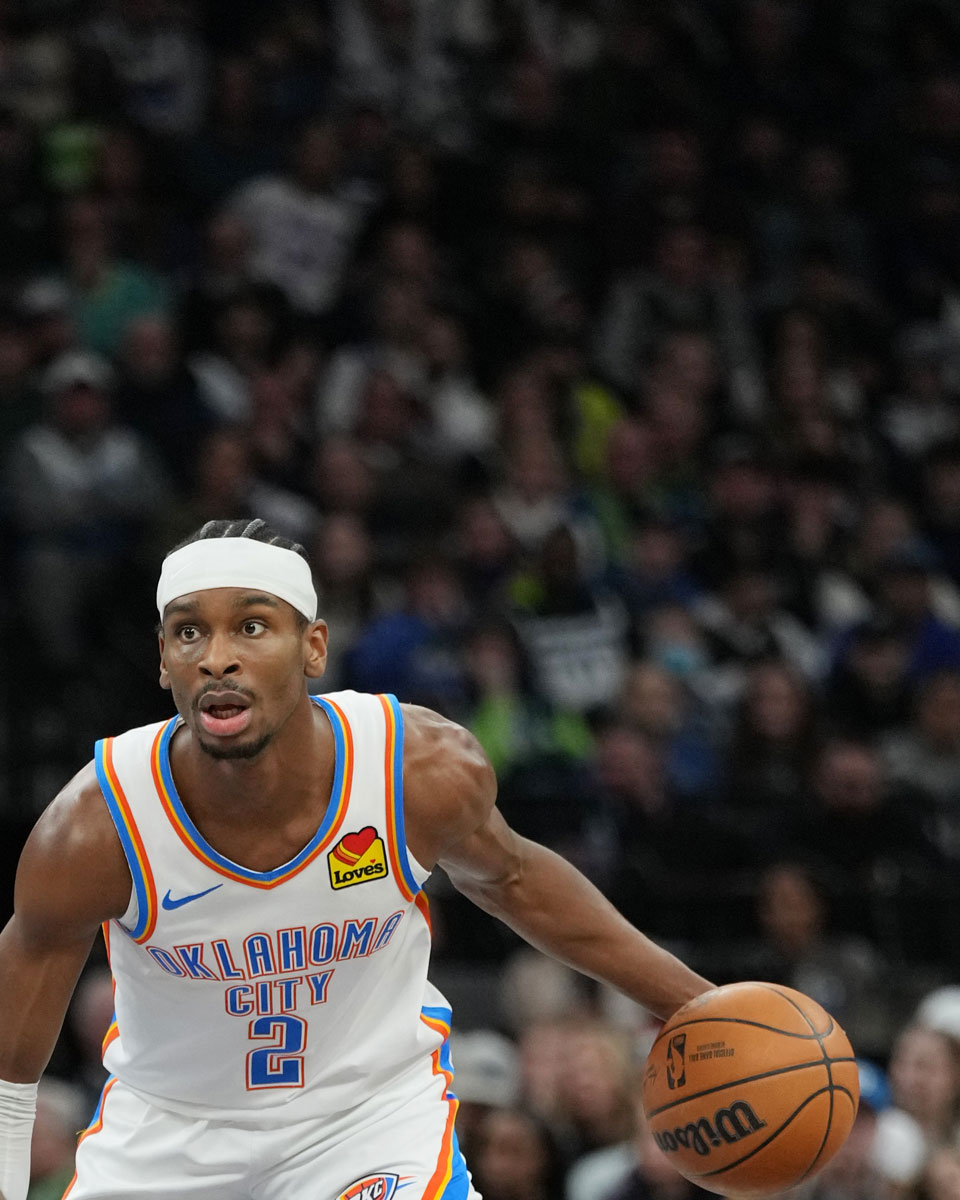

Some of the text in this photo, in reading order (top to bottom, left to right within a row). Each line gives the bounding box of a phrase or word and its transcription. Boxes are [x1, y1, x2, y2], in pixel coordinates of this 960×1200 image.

[146, 910, 405, 981] OKLAHOMA
[225, 969, 335, 1017] CITY
[246, 1013, 307, 1091] 2
[653, 1100, 766, 1156] Wilson
